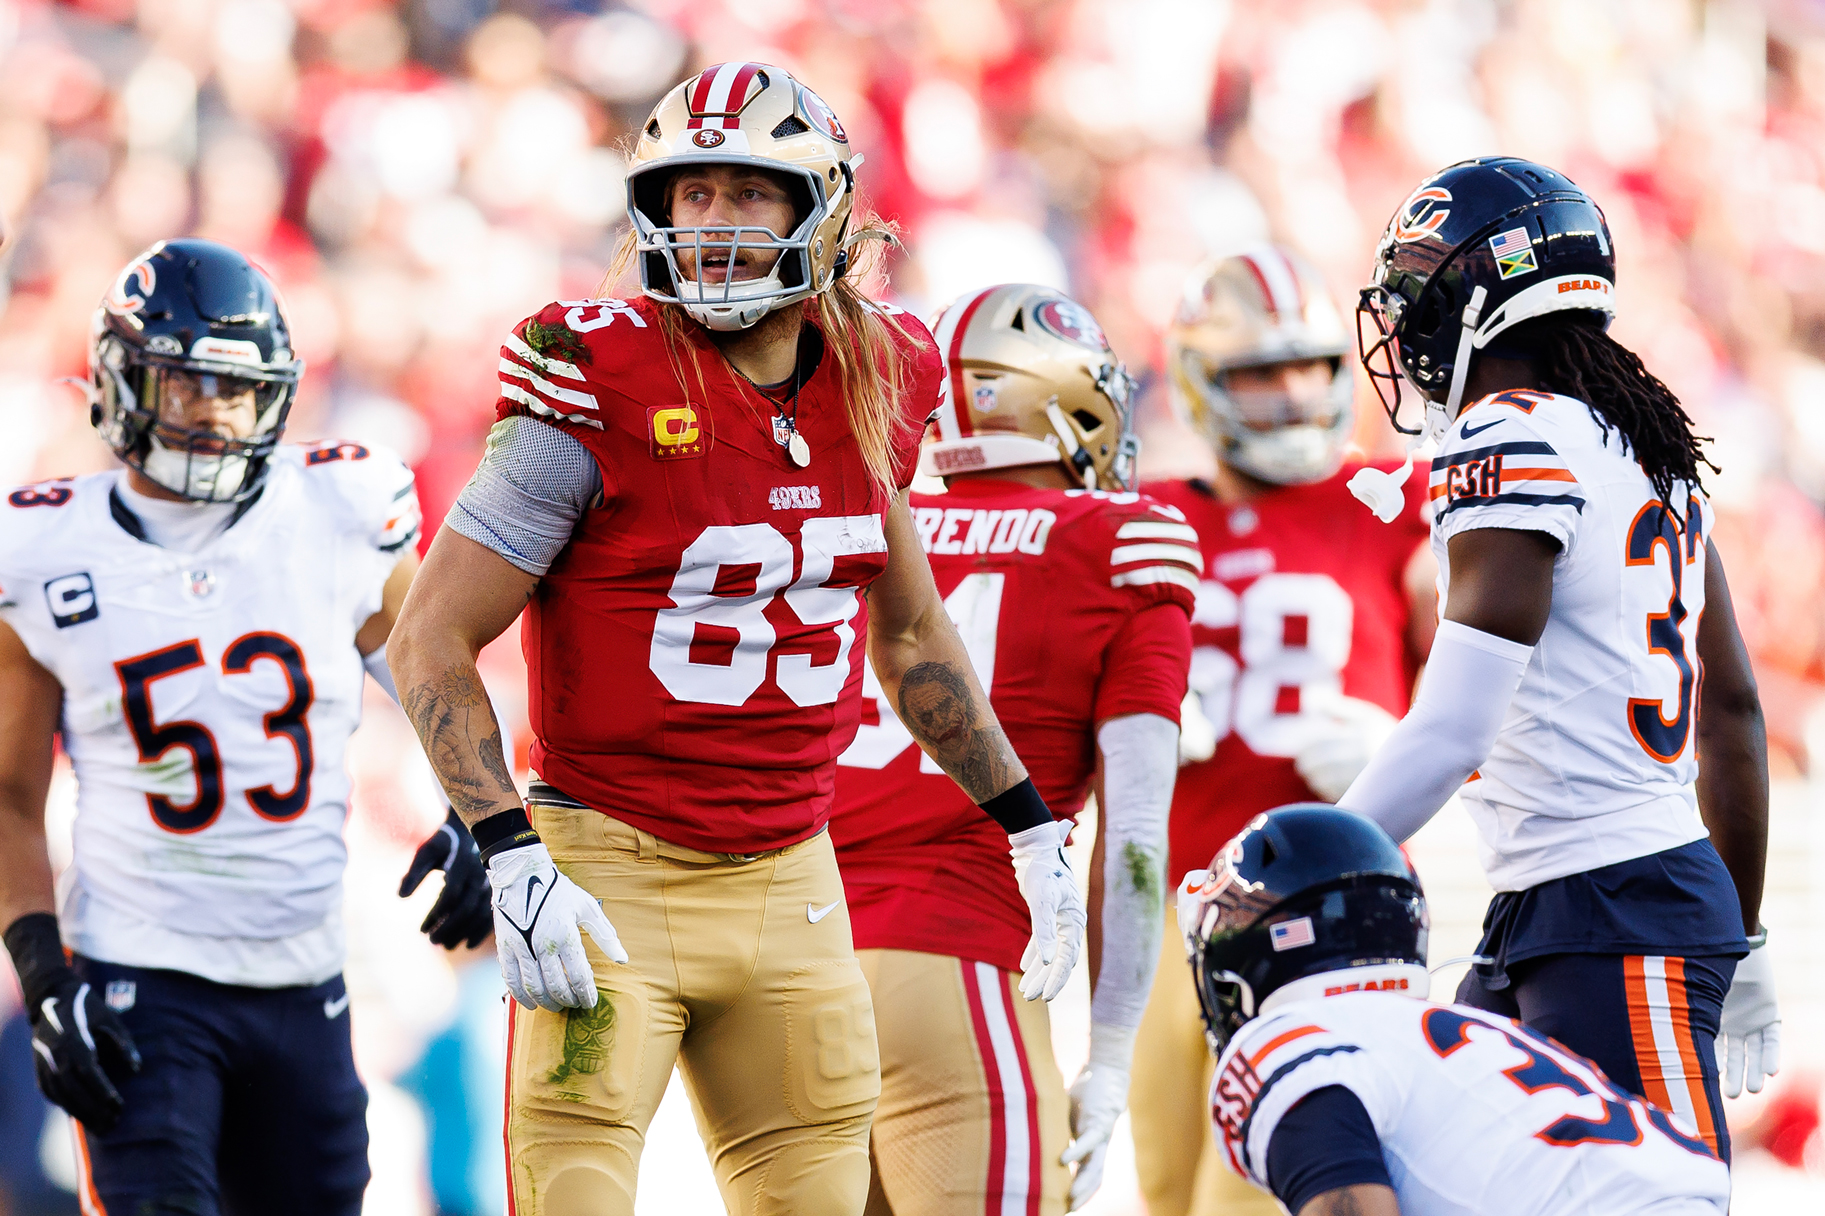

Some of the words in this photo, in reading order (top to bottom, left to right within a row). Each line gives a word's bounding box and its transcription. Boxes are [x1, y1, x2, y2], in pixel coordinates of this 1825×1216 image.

[653, 407, 700, 447] C
[768, 485, 822, 511] 49ERS
[1446, 453, 1504, 504] GSH
[909, 507, 1058, 556] RENDO
[47, 574, 95, 618] C
[649, 513, 888, 708] 85
[113, 631, 315, 835] 53
